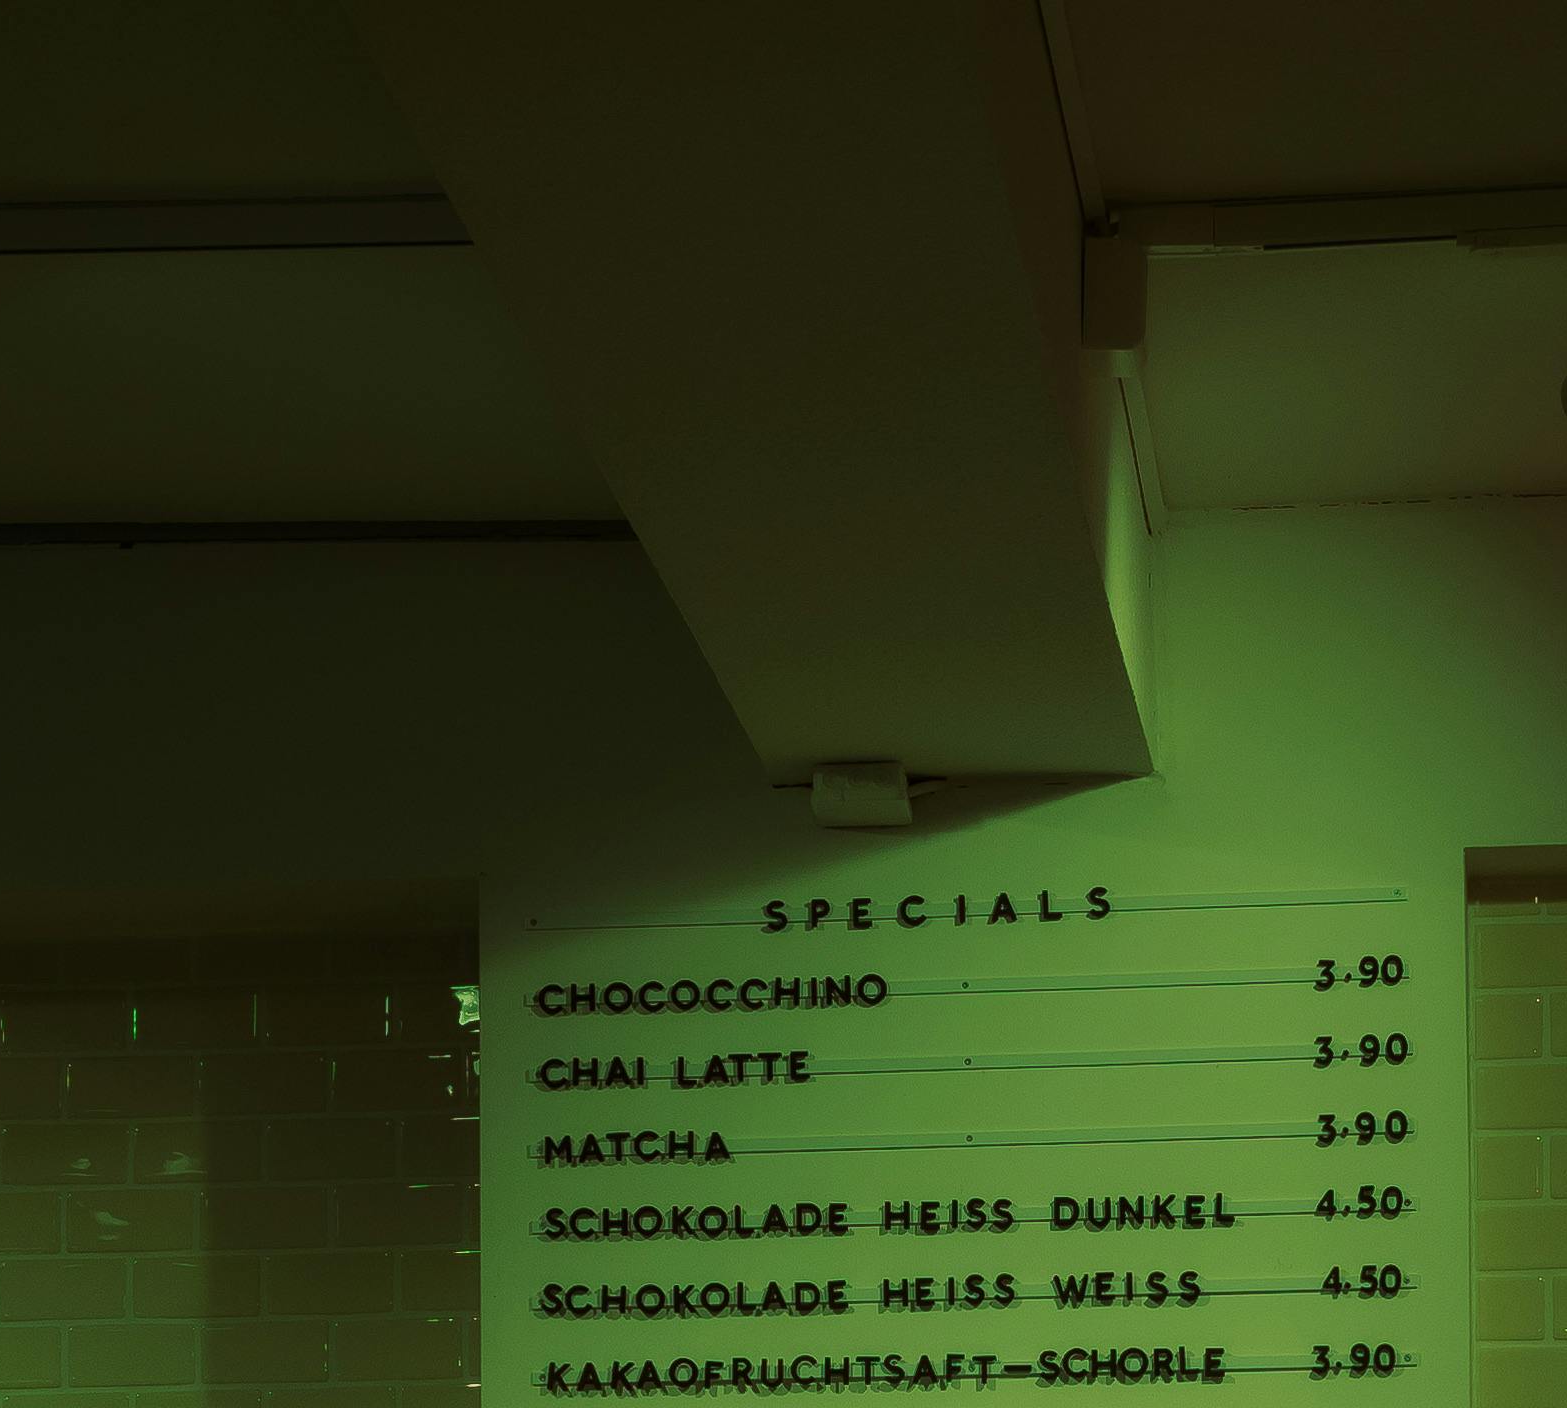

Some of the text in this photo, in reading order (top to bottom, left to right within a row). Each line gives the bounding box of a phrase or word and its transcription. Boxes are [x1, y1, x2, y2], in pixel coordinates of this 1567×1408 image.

[763, 887, 1112, 933] SPECIALS
[536, 955, 1405, 1017] CHOCOCCHINO 3.90
[538, 1032, 1410, 1092] CHAI LATTE 3.90
[542, 1110, 1410, 1165] MATCHA 3.90
[542, 1186, 1405, 1241] SCHOKOLADE HEISS DUNKEL 4.50
[539, 1265, 1403, 1319] SCHOKOLADE HEISS WEISS 4.50
[1310, 1344, 1397, 1377] 3.90
